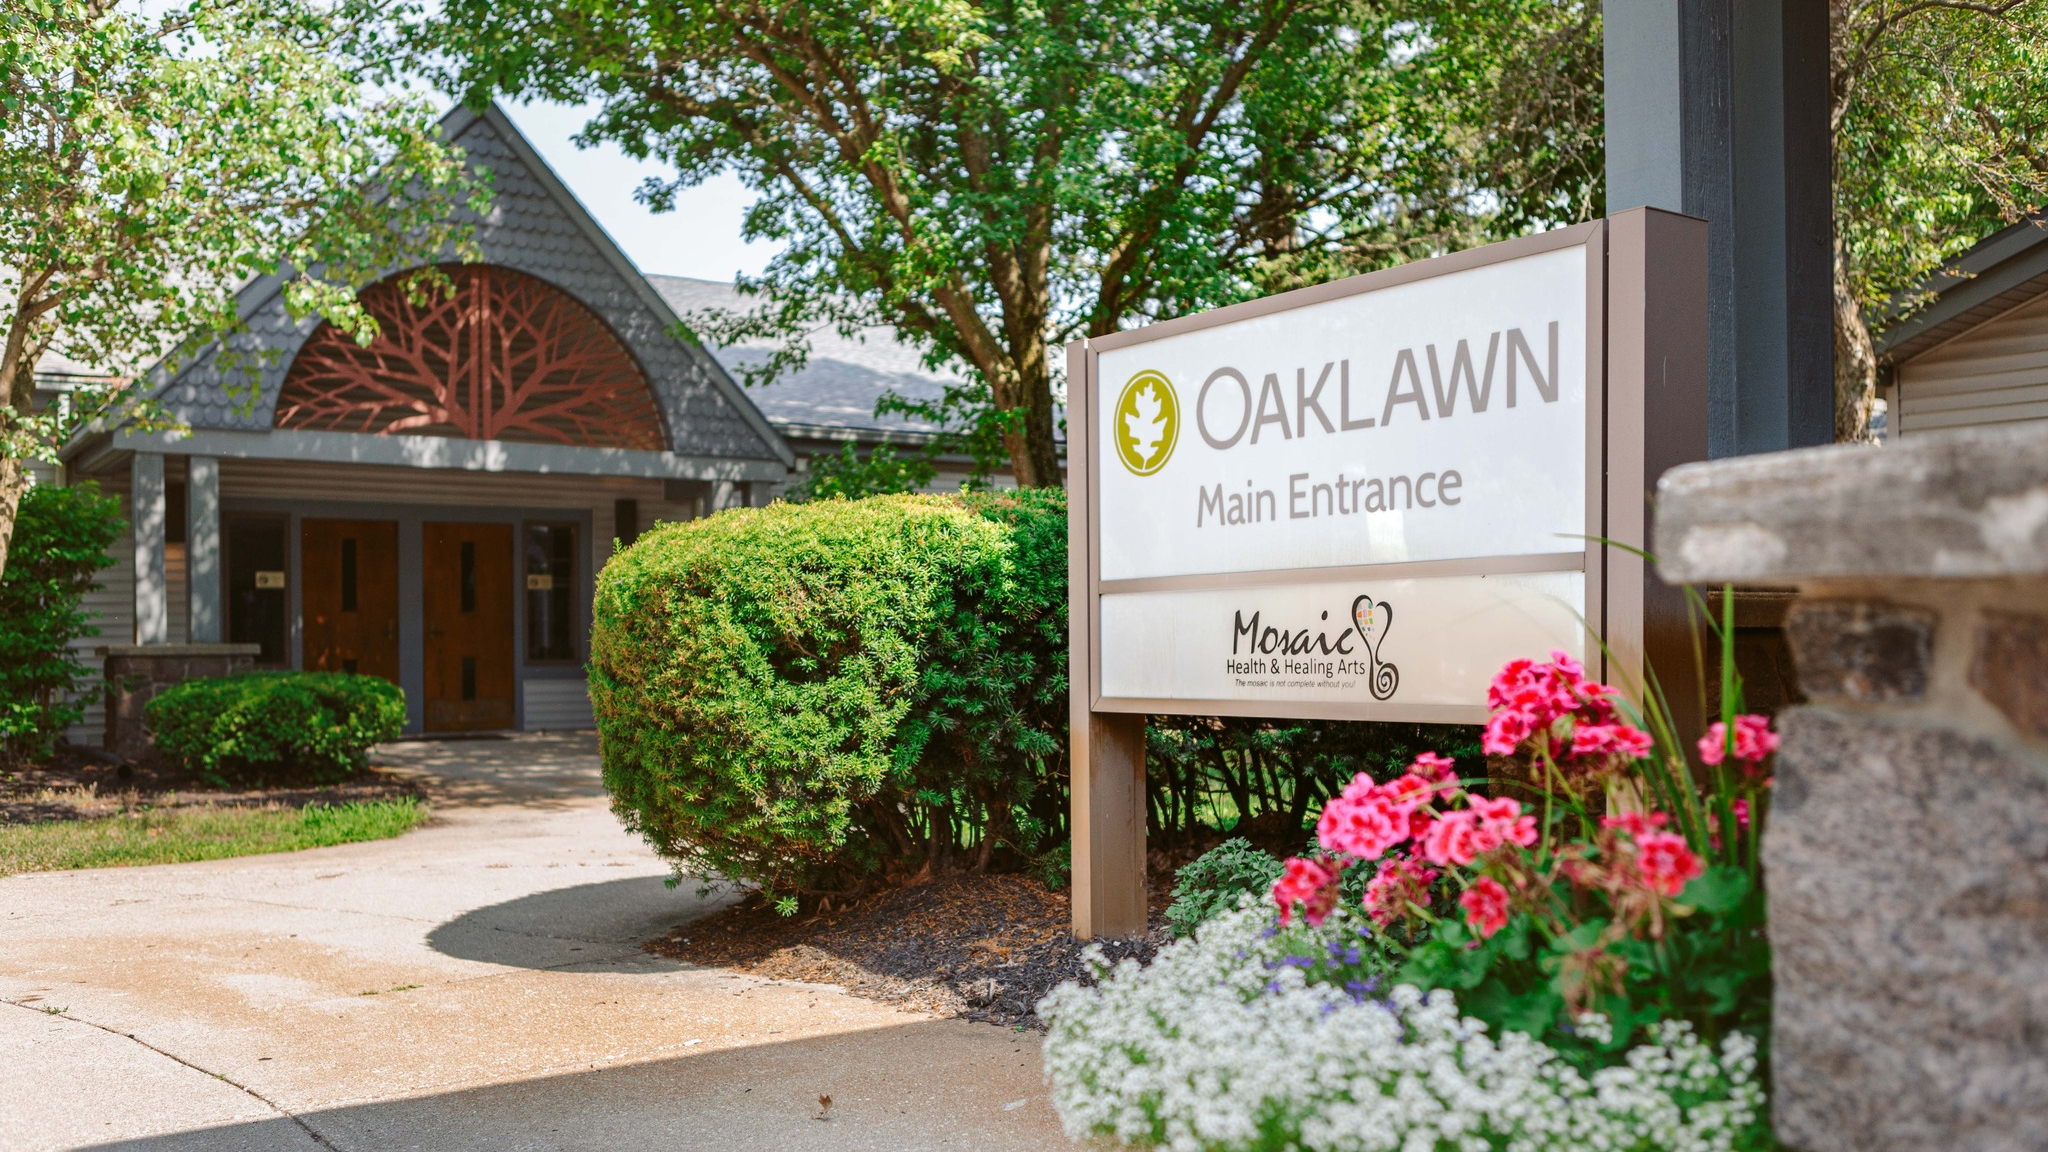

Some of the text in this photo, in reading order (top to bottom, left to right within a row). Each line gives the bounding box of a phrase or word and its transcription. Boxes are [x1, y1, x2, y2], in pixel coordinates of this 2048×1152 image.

[1196, 320, 1560, 451] OAKLAWN
[1197, 468, 1463, 528] Main Entrance
[1233, 609, 1354, 656] Mosaic
[1227, 658, 1366, 679] Health & Healing Arts
[1235, 679, 1246, 687] The
[1247, 679, 1268, 687] mosaic
[1287, 680, 1315, 689] complete
[1317, 680, 1340, 688] without
[1341, 681, 1356, 690] you!
